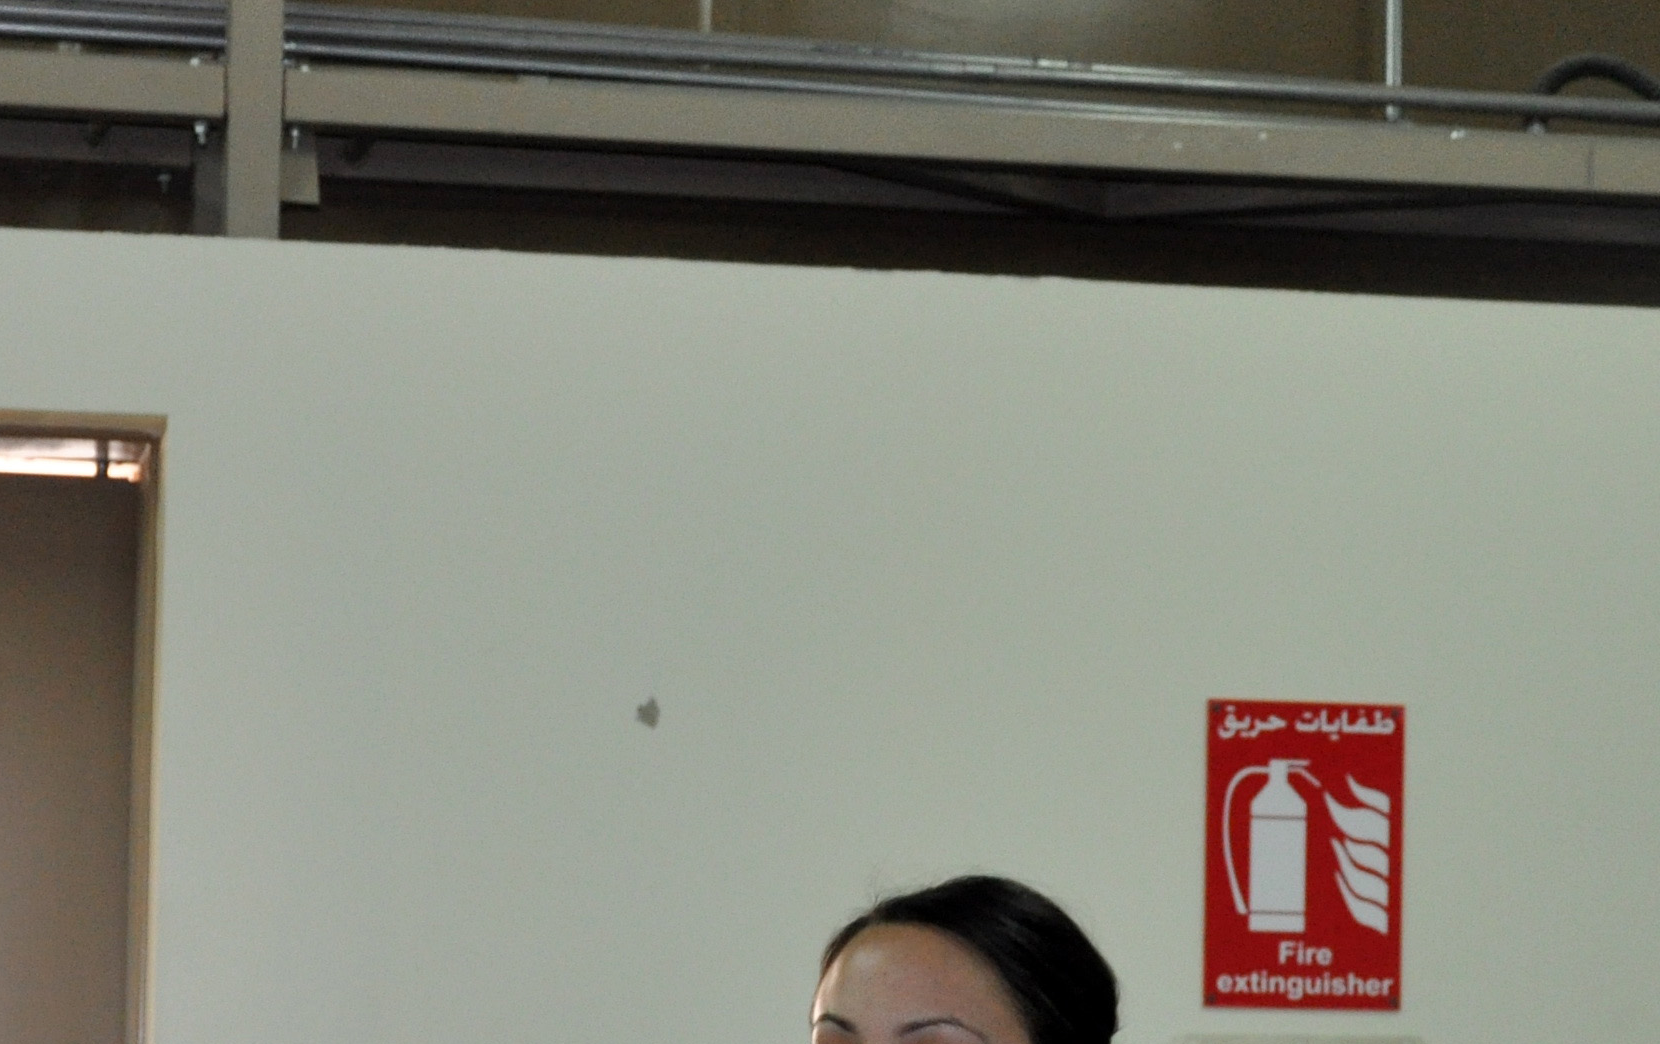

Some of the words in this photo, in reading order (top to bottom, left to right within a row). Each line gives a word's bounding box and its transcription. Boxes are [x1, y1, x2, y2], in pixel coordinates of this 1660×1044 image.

[1218, 705, 1287, 738] حريق
[1278, 941, 1333, 966] Fire
[1216, 970, 1394, 1000] extinguisher
